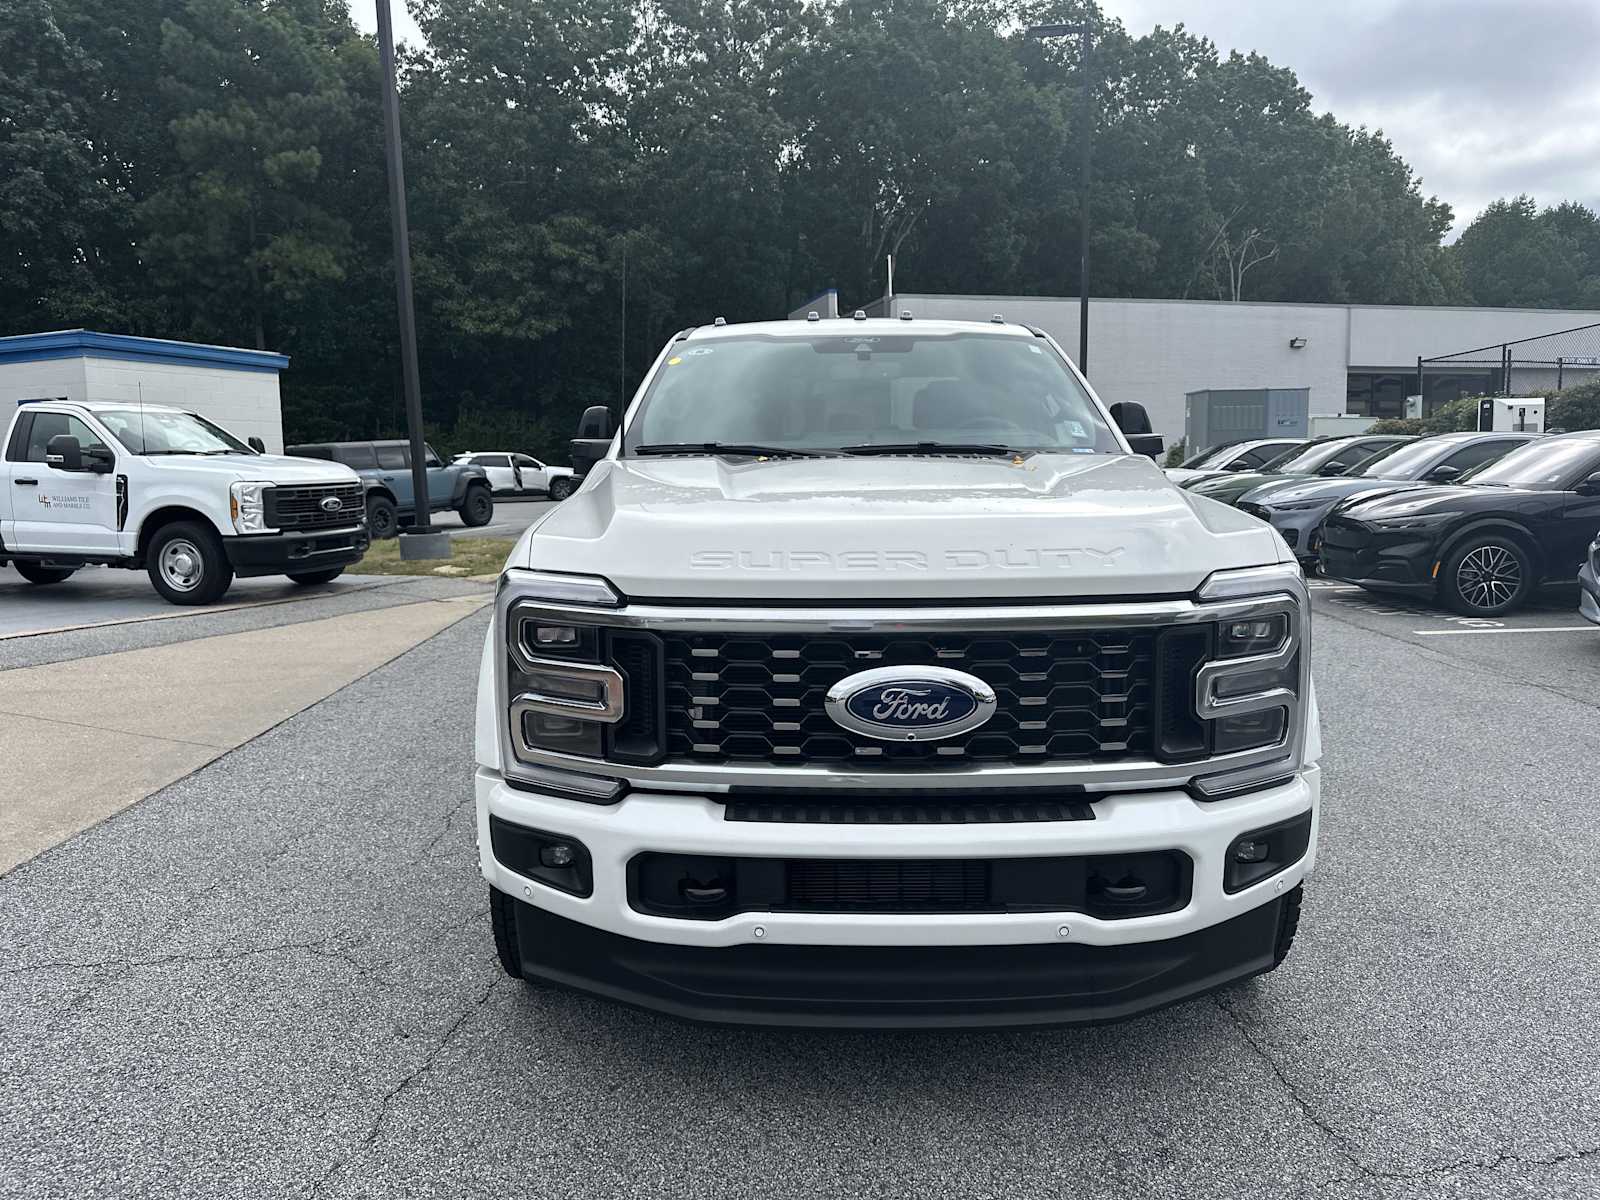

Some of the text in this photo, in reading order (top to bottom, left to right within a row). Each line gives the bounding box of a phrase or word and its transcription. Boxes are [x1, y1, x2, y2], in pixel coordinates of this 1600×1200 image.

[690, 546, 1126, 572] SUPER DUTY
[872, 687, 951, 720] Ford
